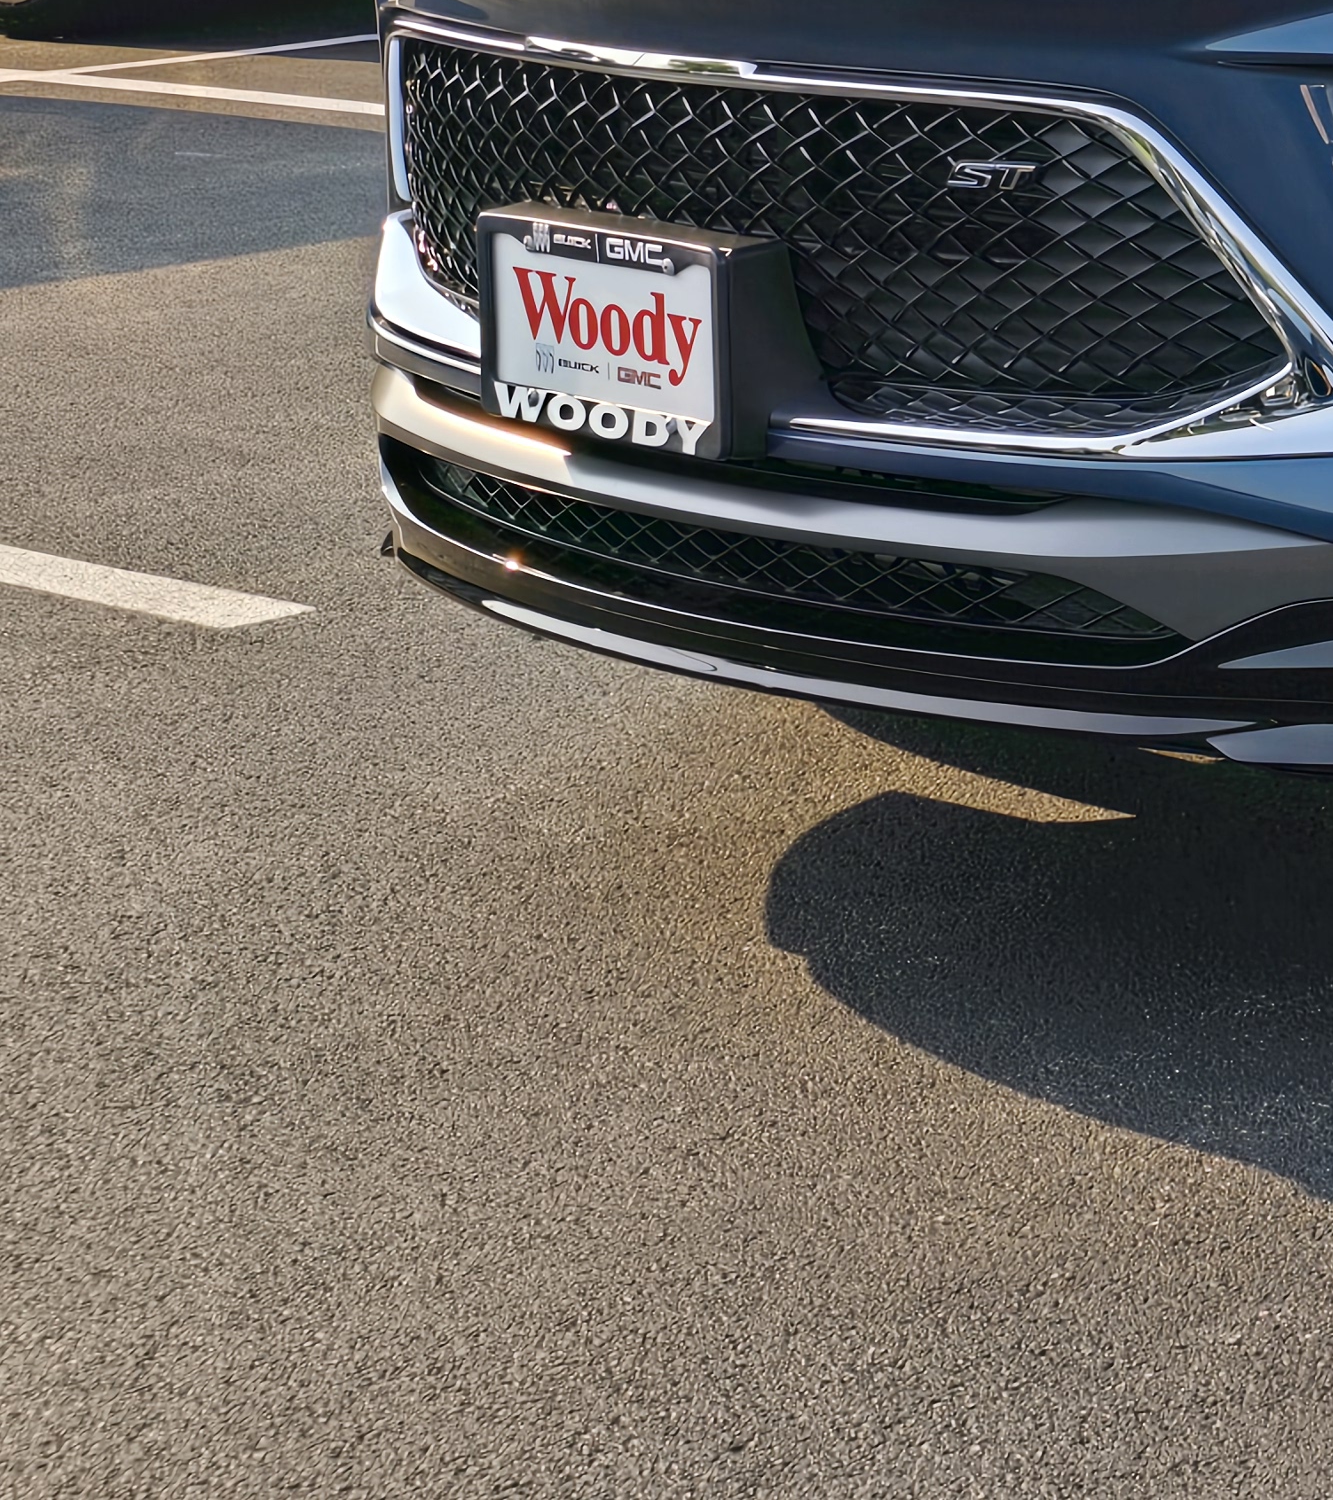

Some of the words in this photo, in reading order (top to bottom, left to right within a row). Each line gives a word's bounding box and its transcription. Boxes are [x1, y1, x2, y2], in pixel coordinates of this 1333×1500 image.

[947, 162, 1036, 190] ST
[553, 234, 592, 249] BUICK
[606, 237, 663, 266] GMC
[512, 266, 703, 387] Woody
[558, 358, 600, 374] BUICK
[617, 366, 662, 390] GMC
[493, 381, 713, 456] WOODY
